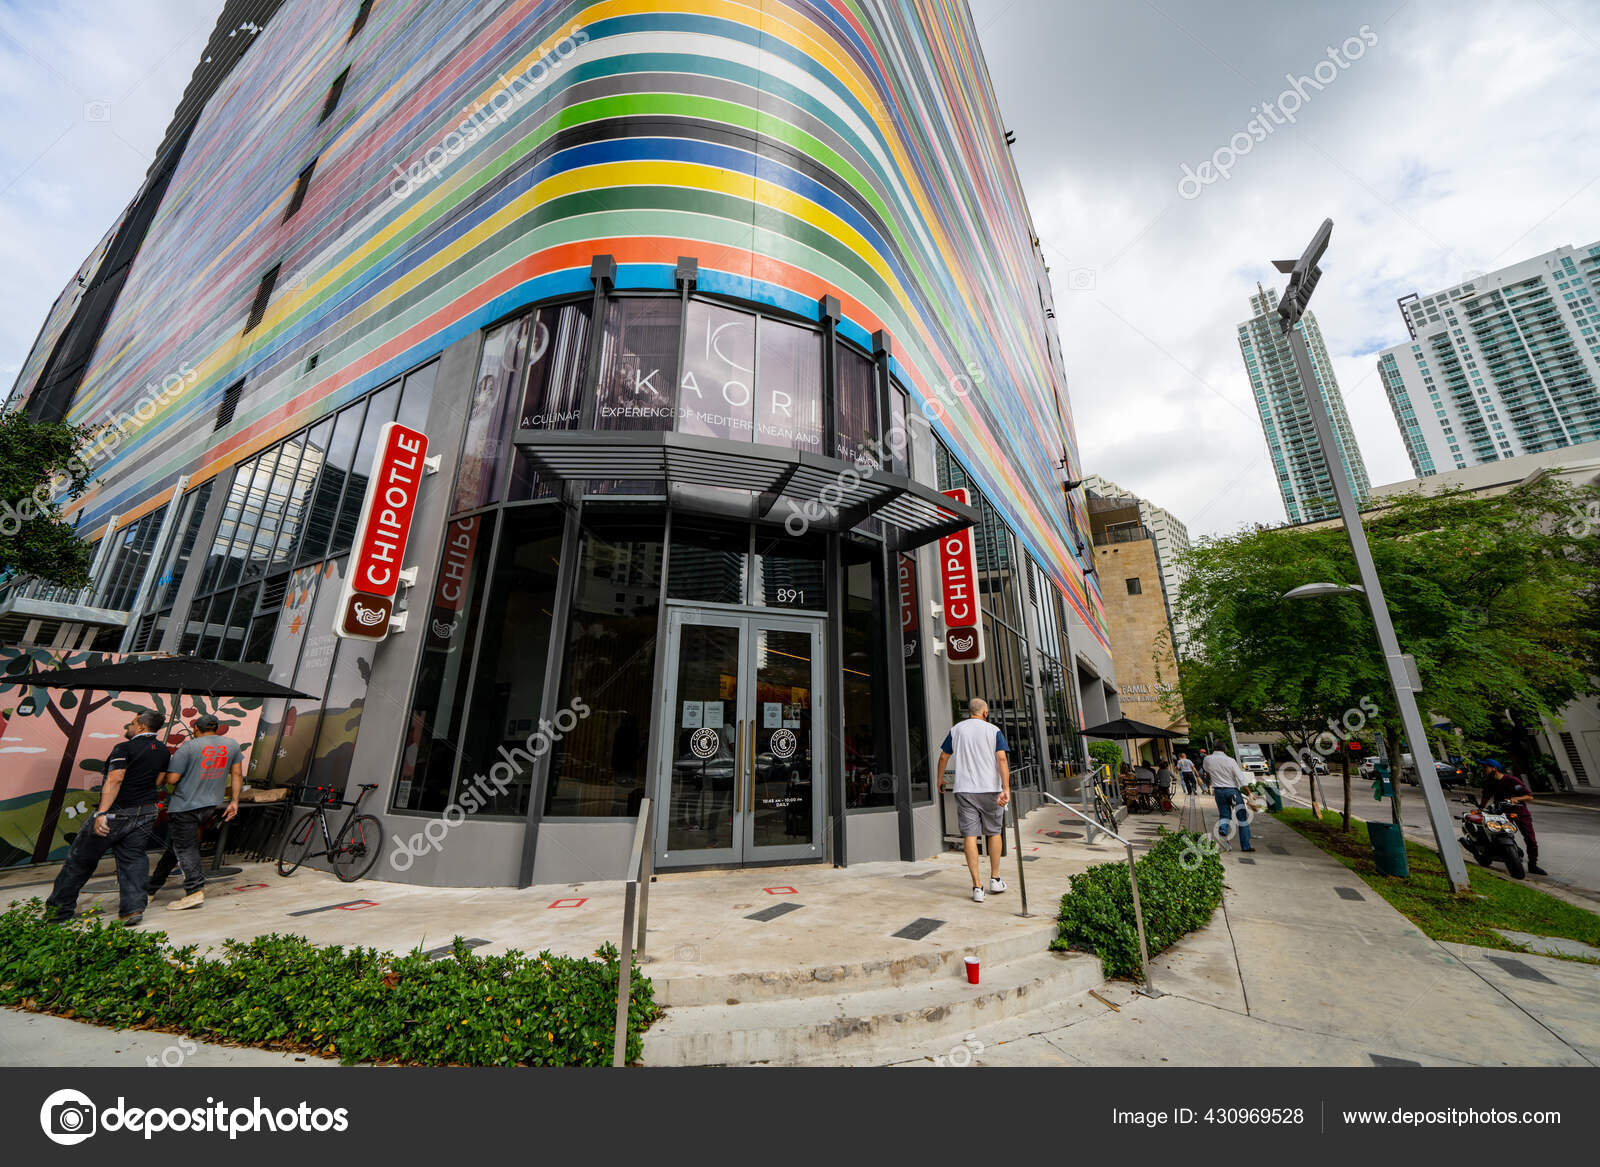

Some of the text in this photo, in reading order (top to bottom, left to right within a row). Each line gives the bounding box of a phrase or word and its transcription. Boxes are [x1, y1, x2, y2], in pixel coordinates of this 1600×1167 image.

[635, 368, 816, 423] KAORI
[521, 416, 530, 427] A
[532, 410, 581, 425] CULINAR
[601, 407, 675, 418] EXPERIENCE
[795, 432, 820, 446] AND
[367, 433, 420, 585] CHIPOTLE
[946, 535, 969, 619] CHIPO
[777, 588, 805, 604] 891
[1121, 684, 1151, 695] FAMILY
[693, 729, 717, 741] CHIPOTLE
[773, 730, 795, 741] CHIPOTLE
[201, 745, 228, 757] G3
